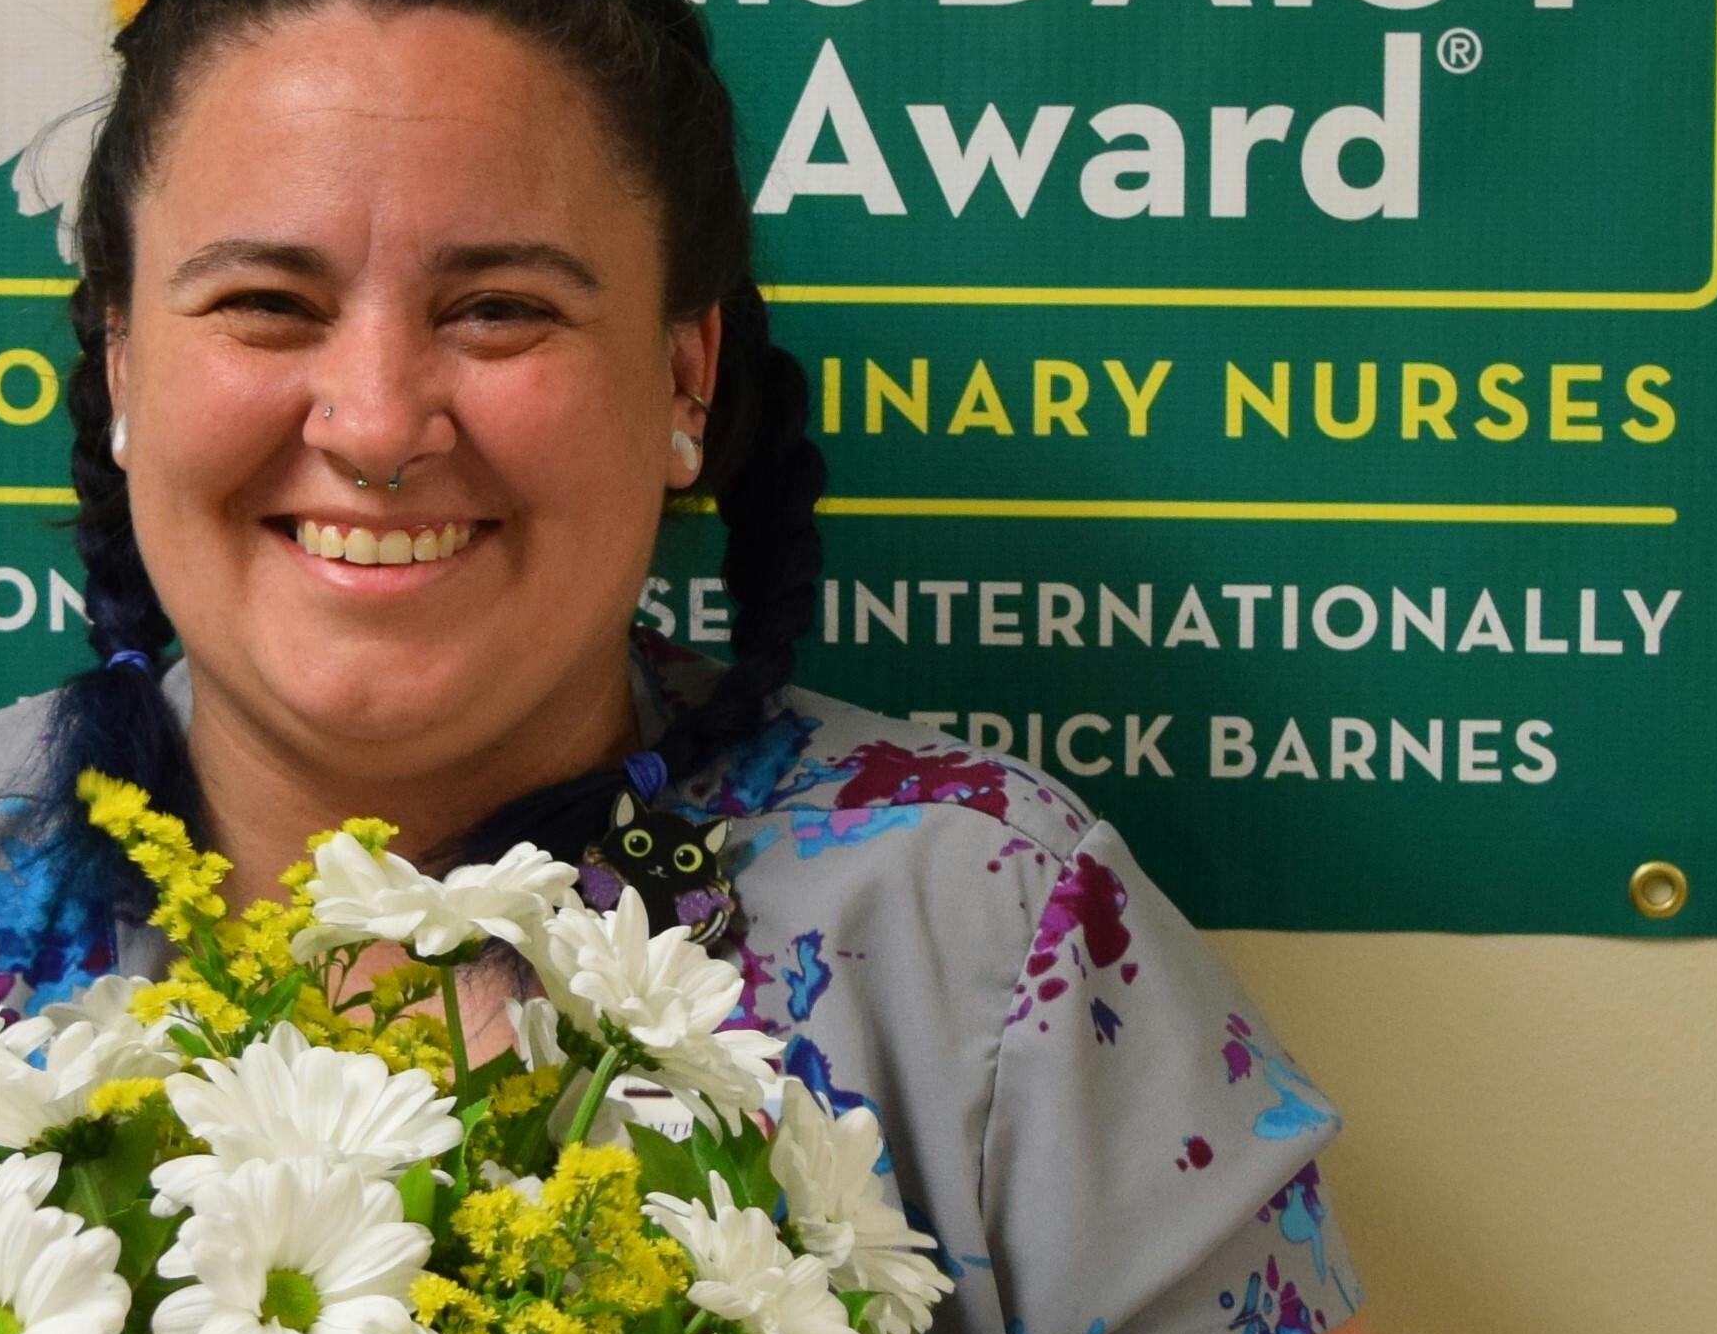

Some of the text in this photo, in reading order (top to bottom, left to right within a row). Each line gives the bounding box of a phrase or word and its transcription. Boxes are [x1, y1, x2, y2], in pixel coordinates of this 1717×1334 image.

[1225, 362, 1676, 443] NURSES
[824, 580, 1683, 656] INTERNATIONALLY
[1209, 716, 1558, 785] BARNES
